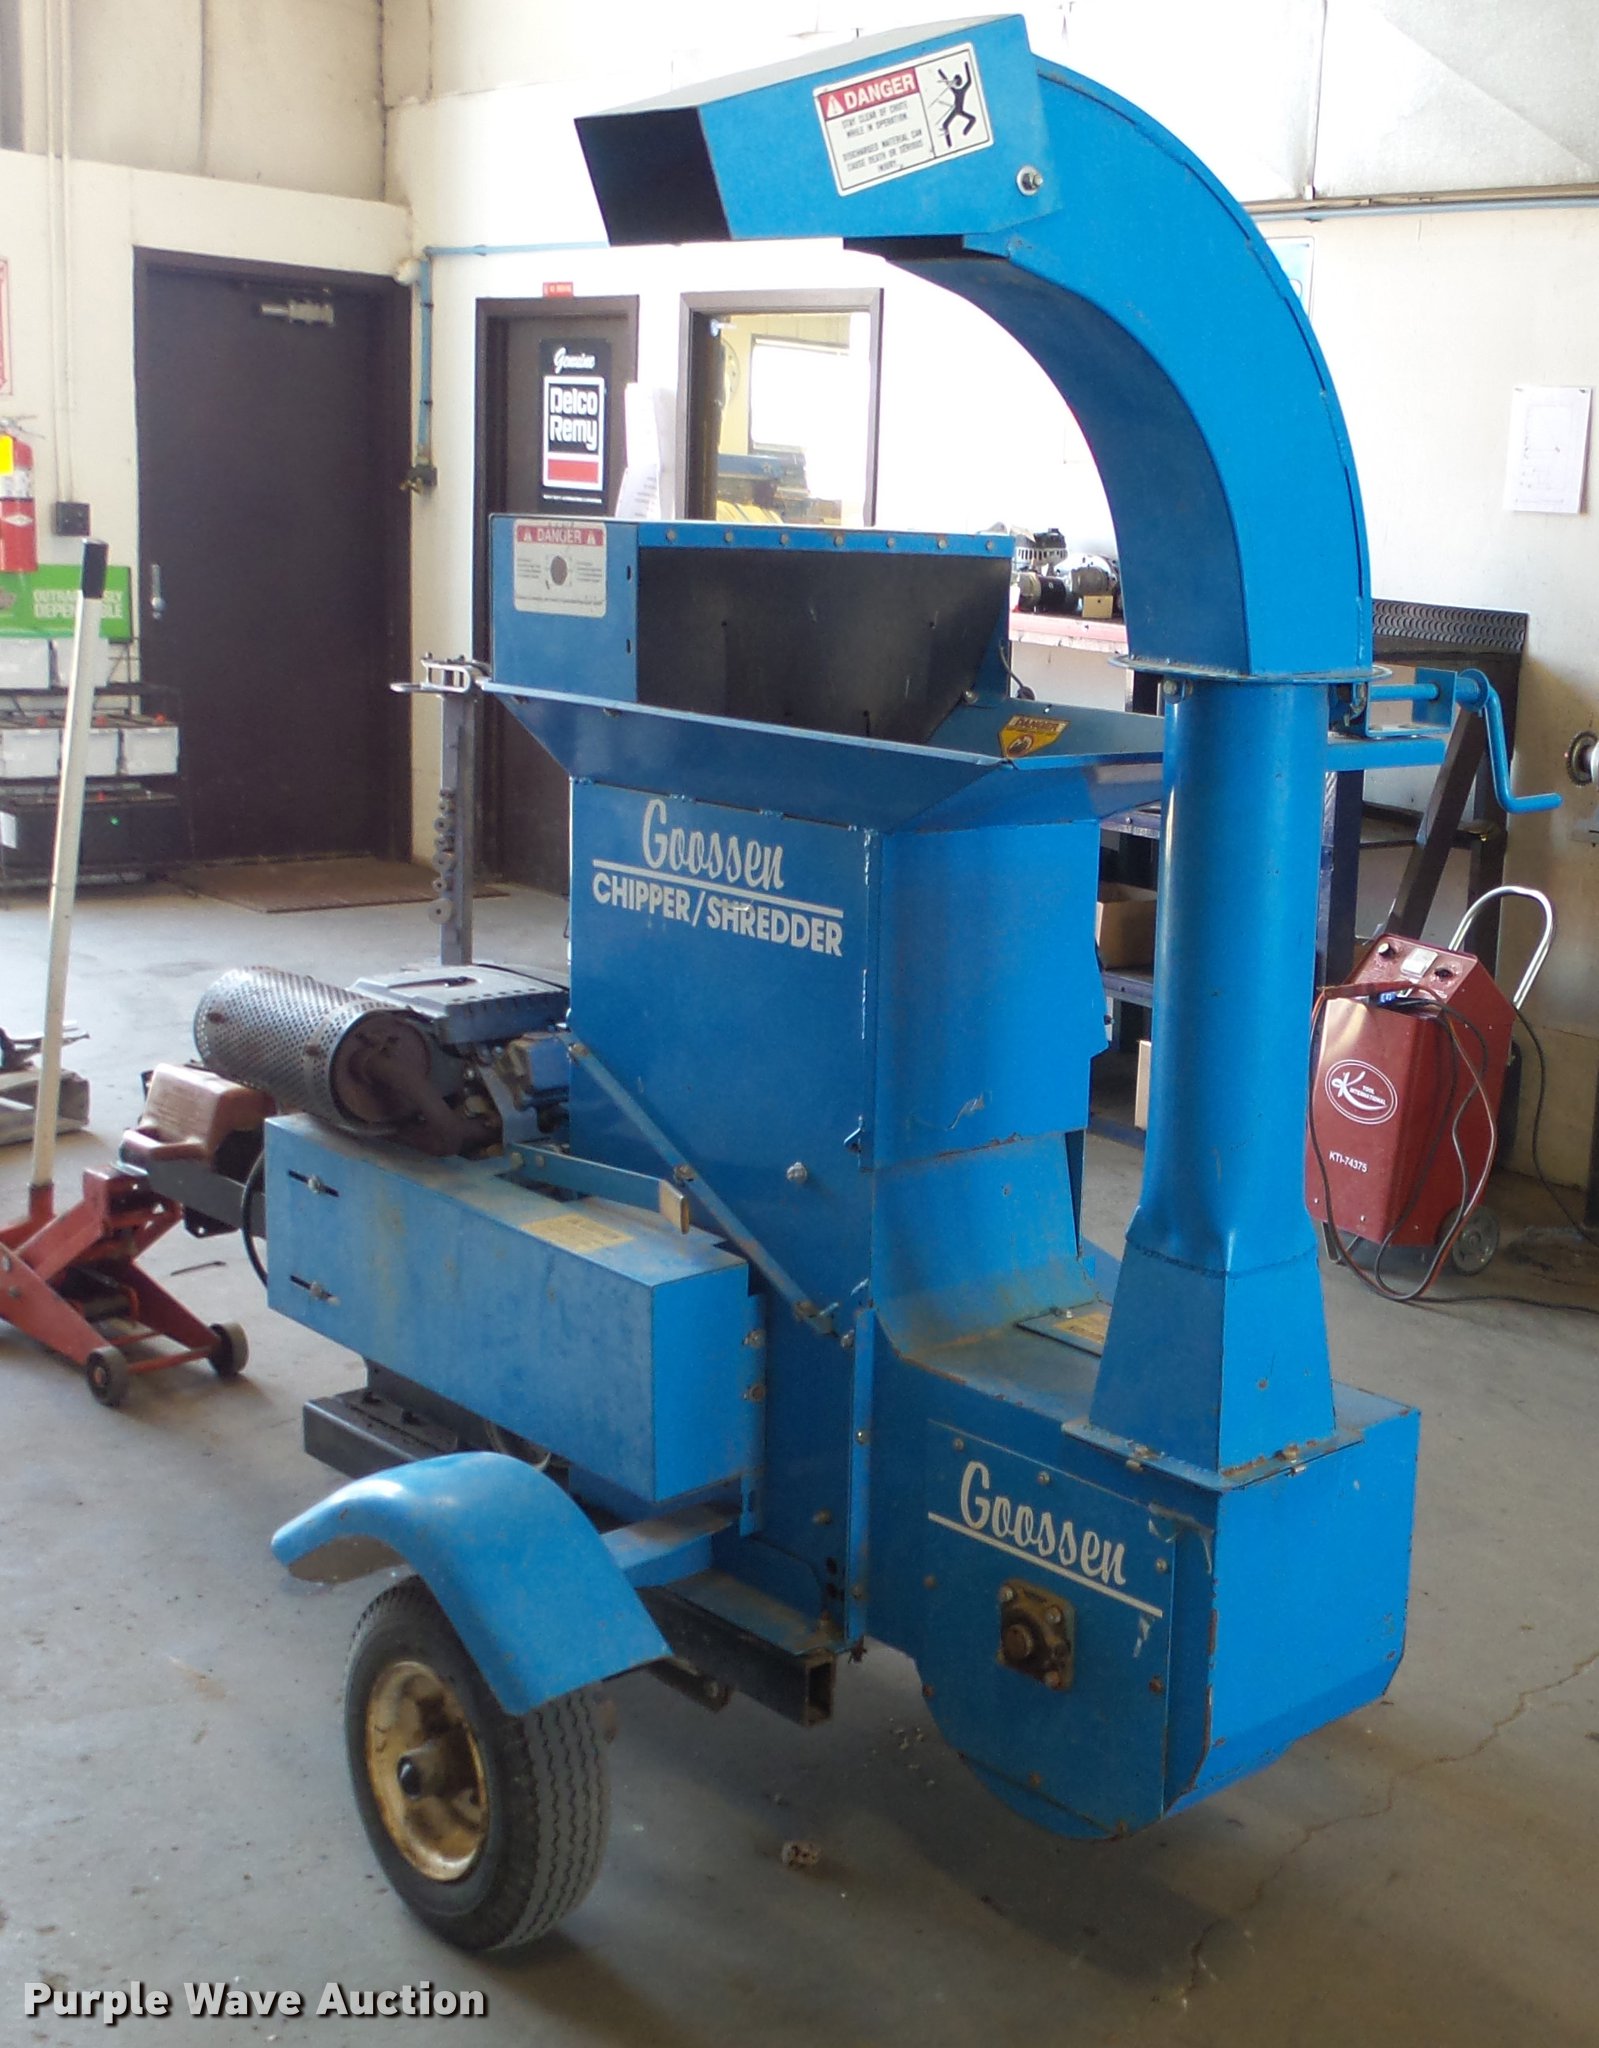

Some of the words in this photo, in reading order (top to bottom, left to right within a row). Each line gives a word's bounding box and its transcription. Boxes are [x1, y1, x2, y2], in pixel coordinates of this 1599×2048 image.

[843, 73, 916, 109] DANGER
[554, 347, 595, 374] Genuine
[550, 386, 598, 415] Delco
[550, 414, 598, 452] Remy
[537, 528, 582, 544] DANGER
[642, 799, 784, 891] Goossen
[1329, 1151, 1368, 1173] KTI-74375
[960, 1460, 1126, 1585] Goossen
